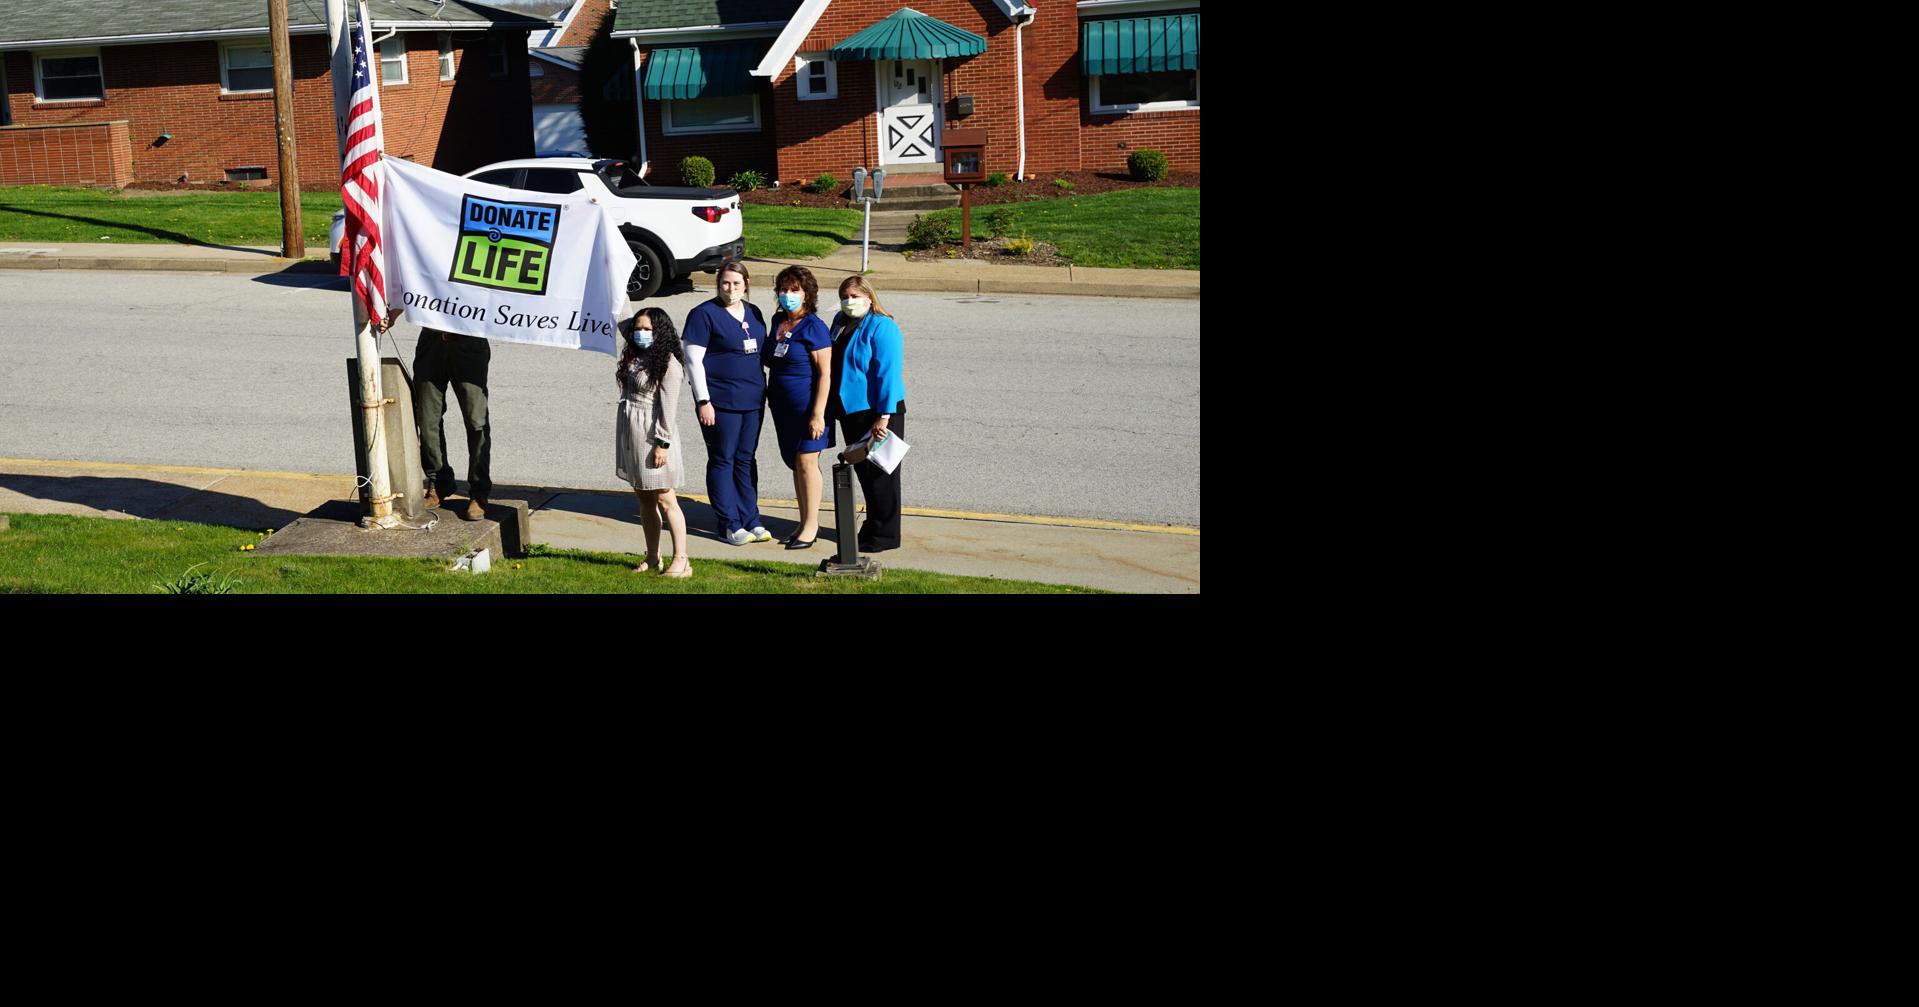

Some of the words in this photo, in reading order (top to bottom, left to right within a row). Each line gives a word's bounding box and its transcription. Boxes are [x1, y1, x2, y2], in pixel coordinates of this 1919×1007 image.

[470, 202, 551, 231] DONATE
[461, 241, 543, 285] LIFE
[401, 286, 486, 321] onation
[494, 304, 559, 330] Saves
[567, 310, 613, 338] Live
